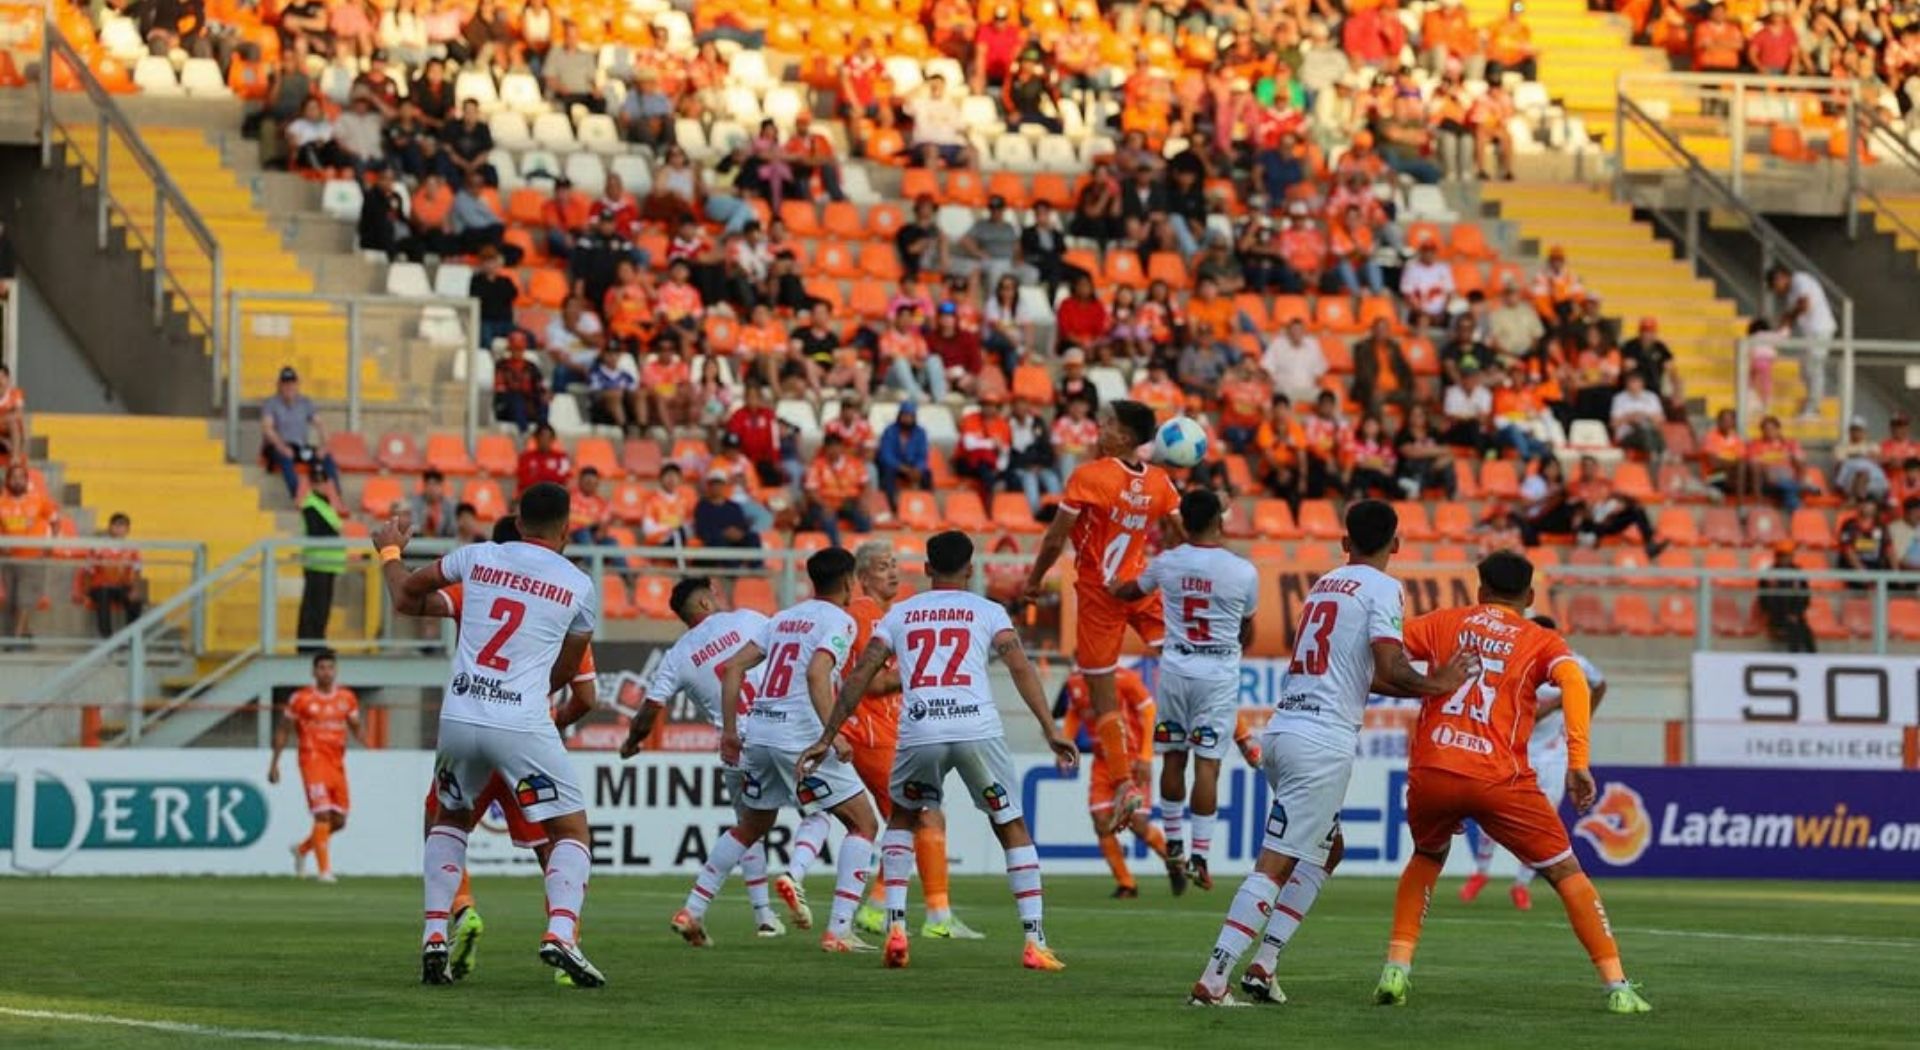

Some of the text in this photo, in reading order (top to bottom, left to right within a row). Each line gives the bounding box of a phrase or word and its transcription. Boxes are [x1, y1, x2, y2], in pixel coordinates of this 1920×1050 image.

[470, 564, 574, 607] MONTESEIRIN
[1102, 533, 1131, 586] 4
[1181, 578, 1212, 594] LEON
[476, 597, 526, 672] 2
[904, 608, 974, 624] ZAFARANA
[1183, 596, 1213, 643] 5
[1290, 601, 1339, 676] 23
[759, 643, 801, 698] 16
[907, 628, 971, 690] 22
[1742, 664, 1920, 725] SO
[3, 762, 247, 872] DERK
[590, 825, 650, 865] EL
